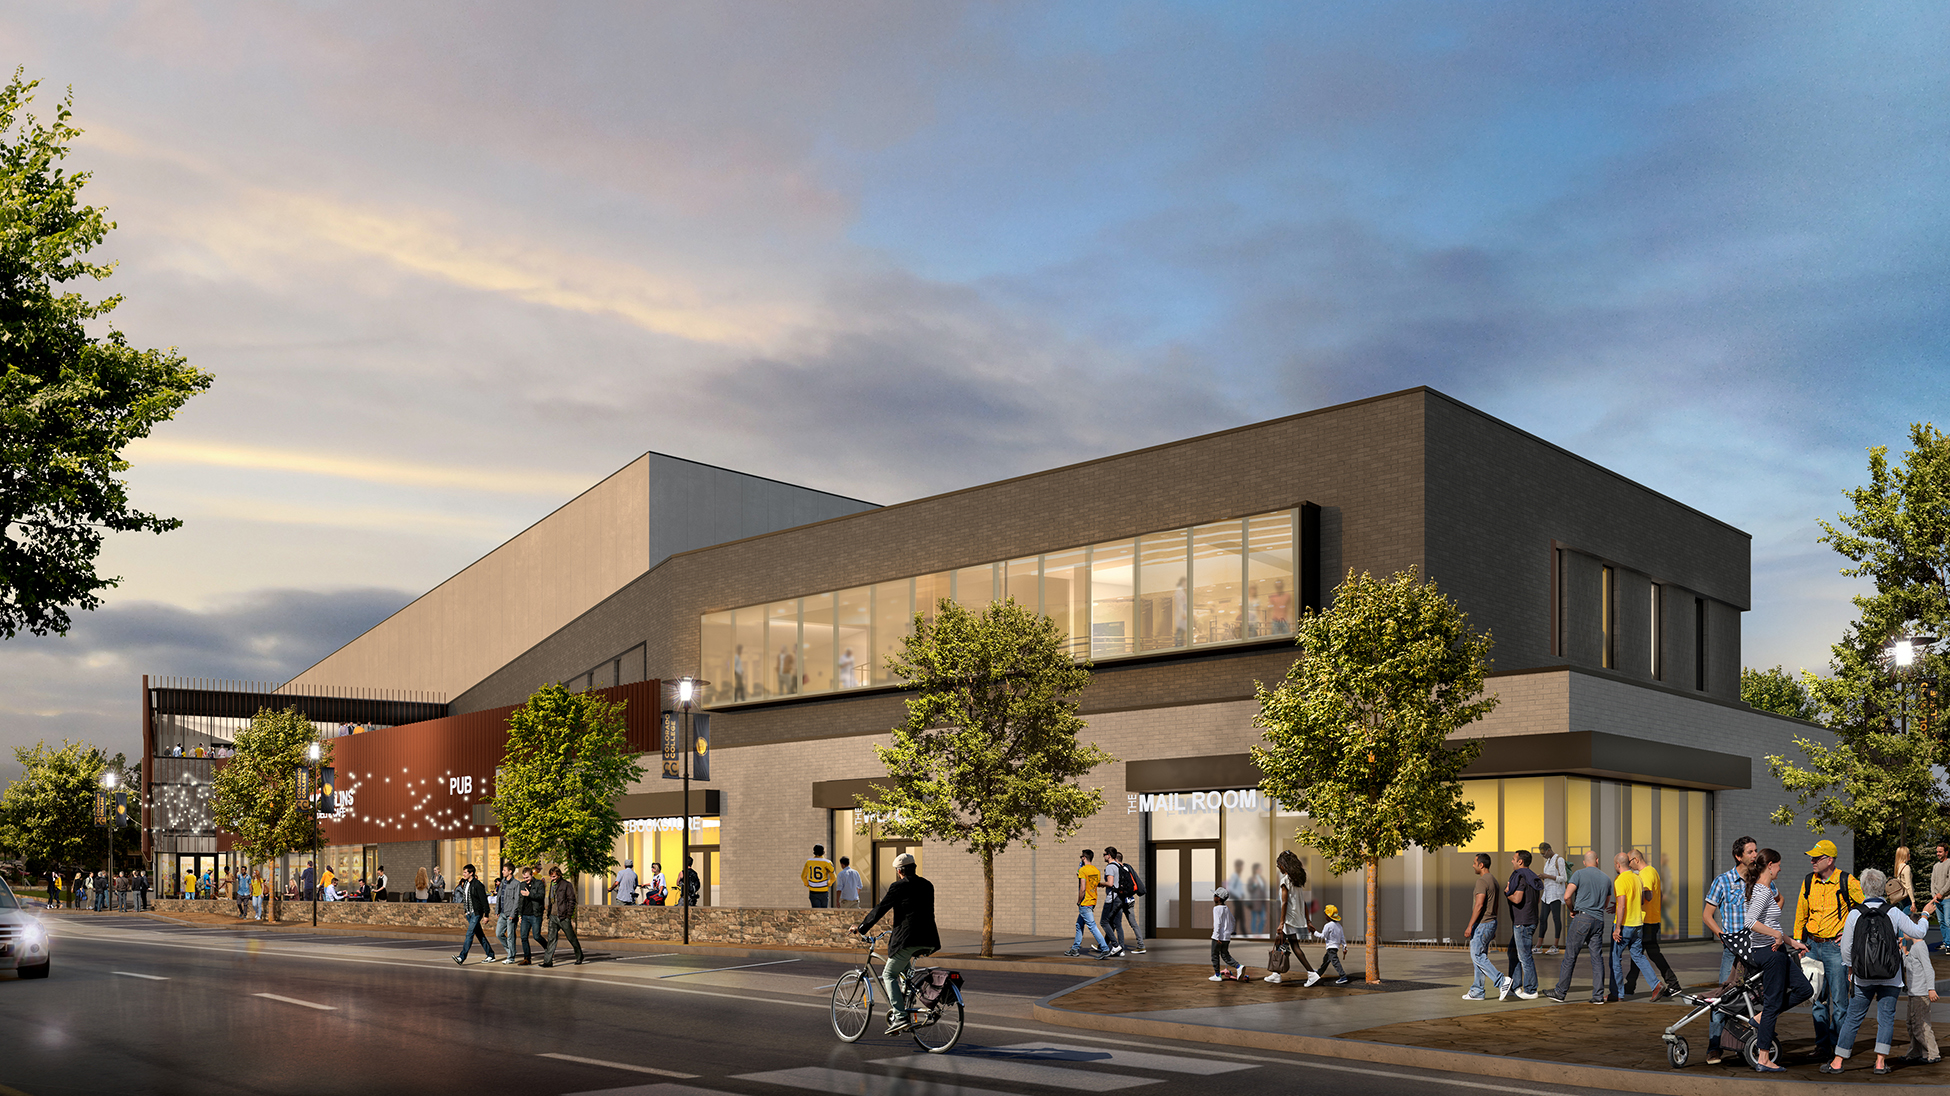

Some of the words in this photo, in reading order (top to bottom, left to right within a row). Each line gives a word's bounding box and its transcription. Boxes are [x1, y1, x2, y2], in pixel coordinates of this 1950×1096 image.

[450, 776, 473, 795] PUB
[1127, 794, 1137, 815] THE
[1139, 793, 1186, 812] MAIL
[1192, 789, 1257, 810] ROOM
[629, 816, 701, 832] BOOKSTORE
[809, 866, 823, 880] 16
